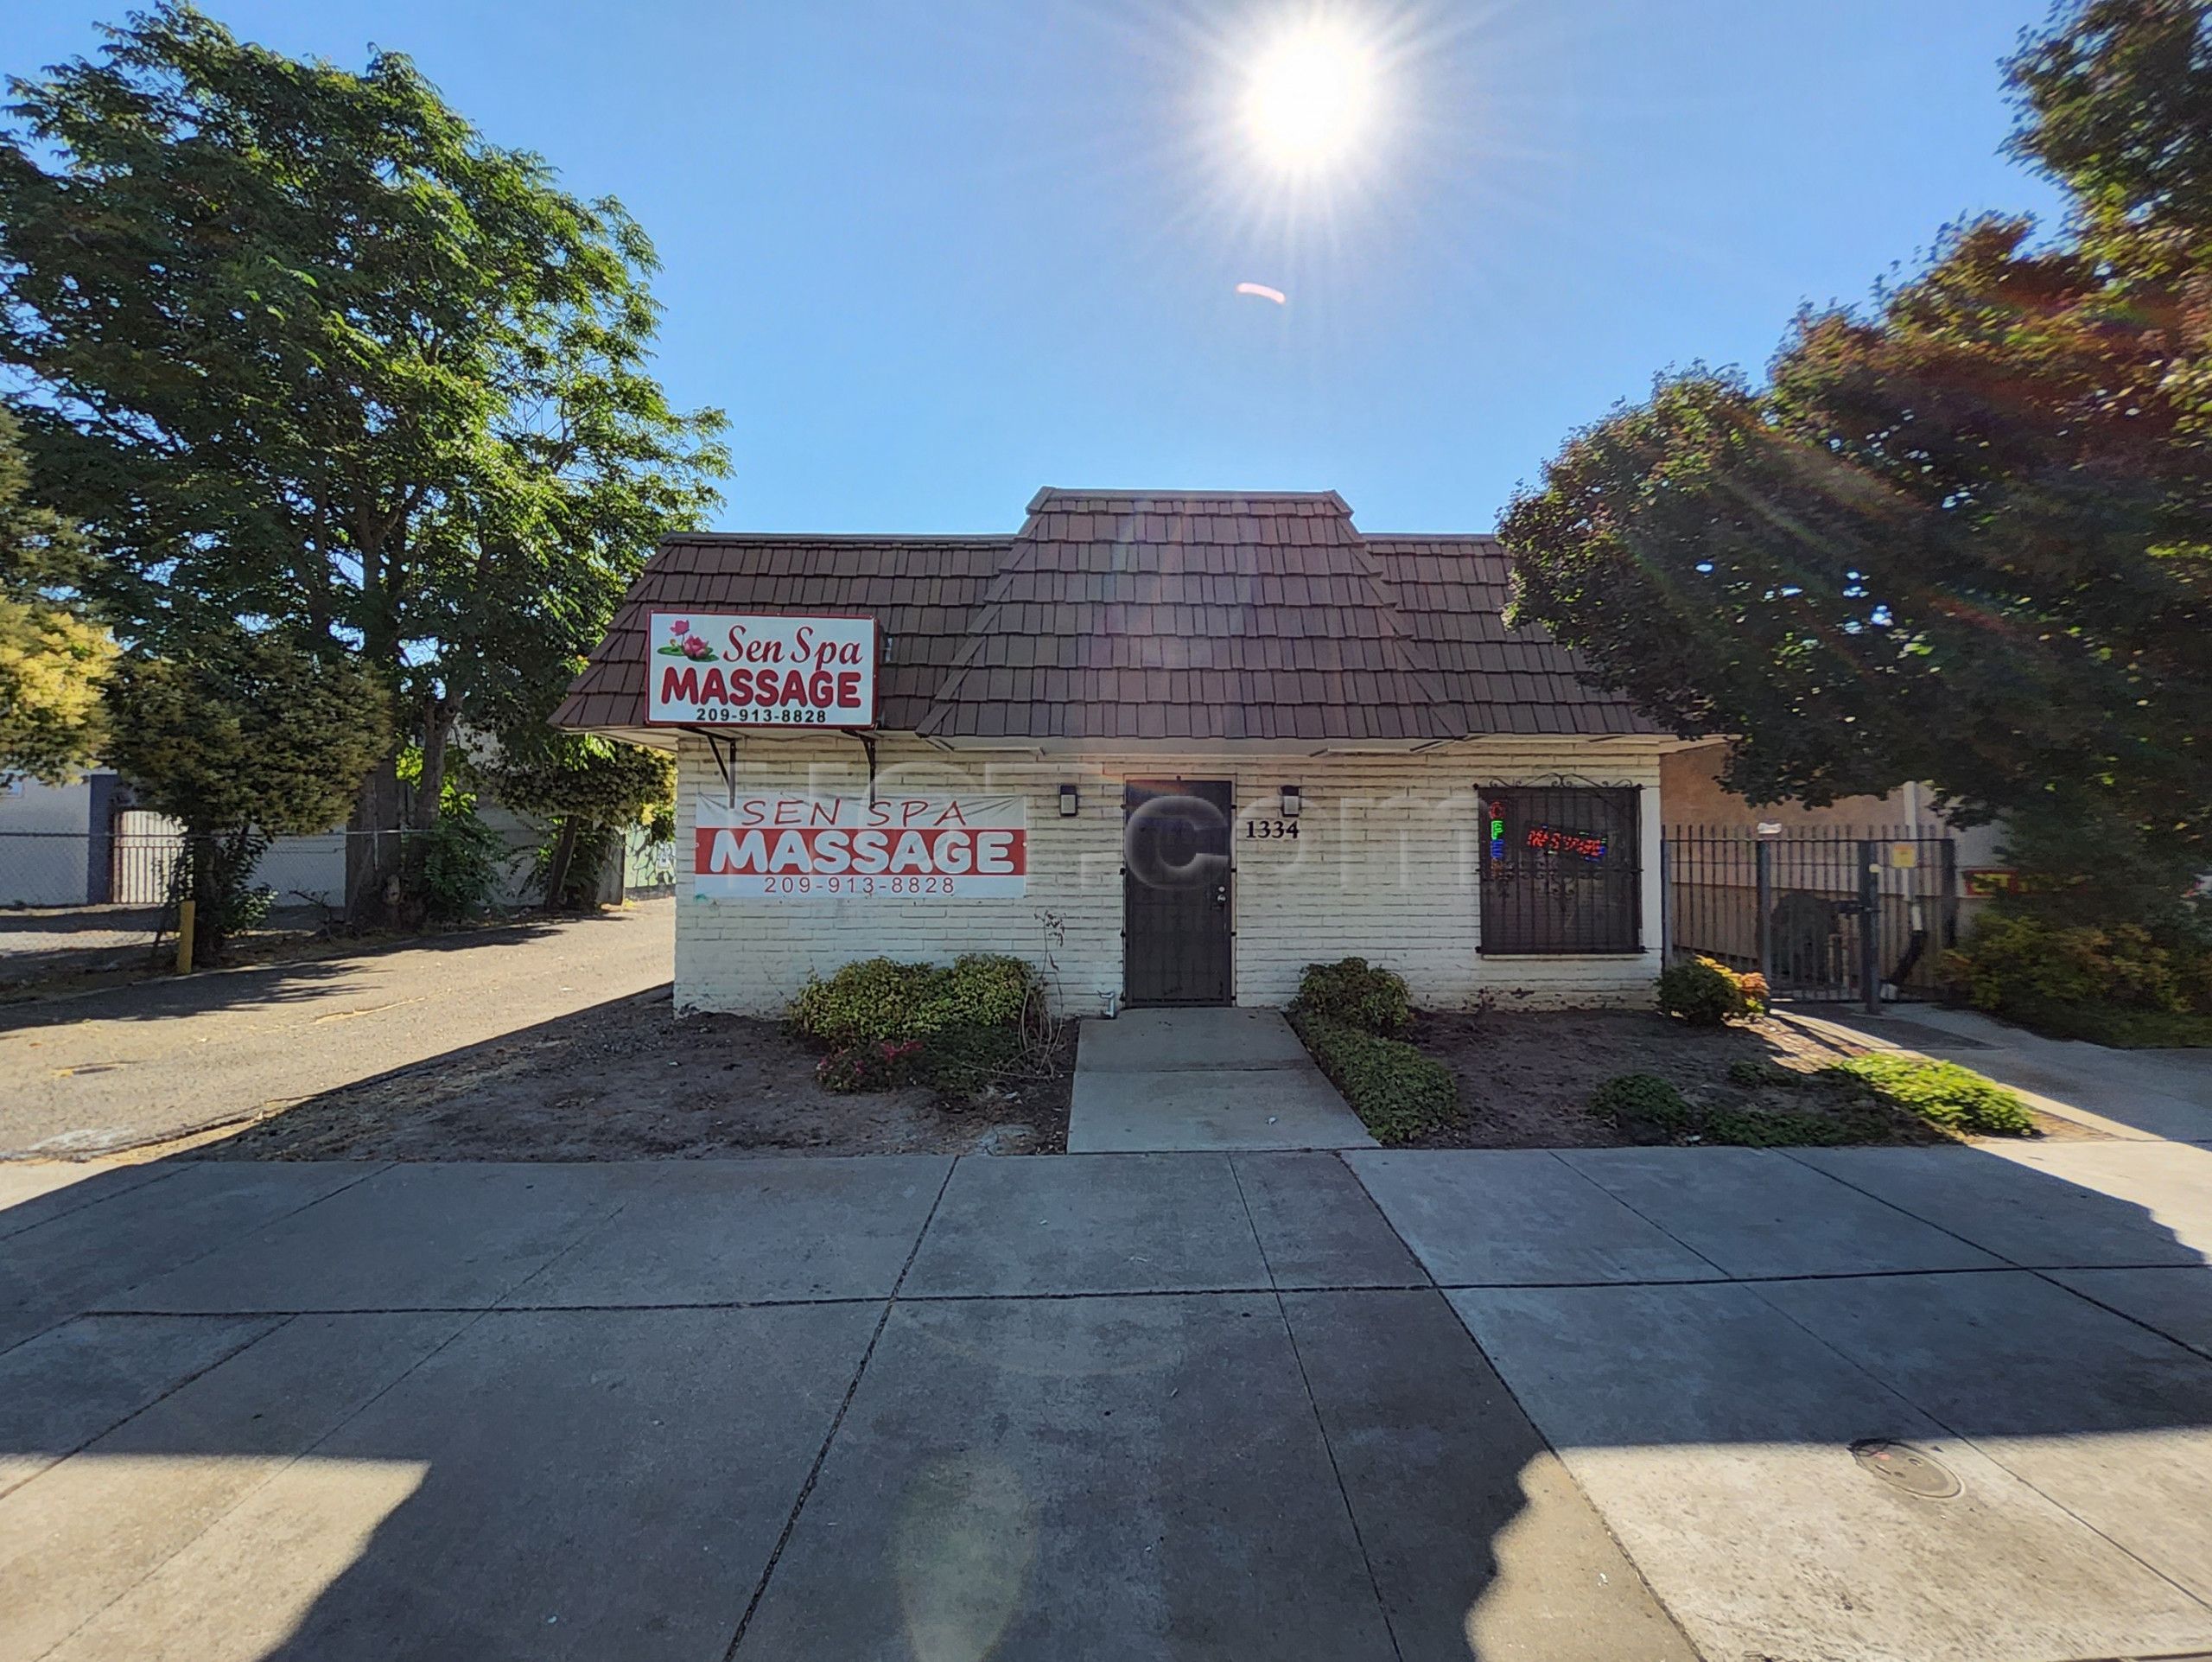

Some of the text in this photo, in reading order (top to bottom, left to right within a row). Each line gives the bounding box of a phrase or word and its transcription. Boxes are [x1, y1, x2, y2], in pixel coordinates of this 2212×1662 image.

[722, 624, 863, 671] Sen Spa
[661, 666, 861, 708] MASSAGE
[696, 708, 826, 723] 209-913-8828
[741, 798, 966, 827] SEN SPA
[1246, 820, 1300, 839] 1334
[710, 830, 1014, 873] MASSAGE
[764, 876, 954, 894] 209-913-8828
